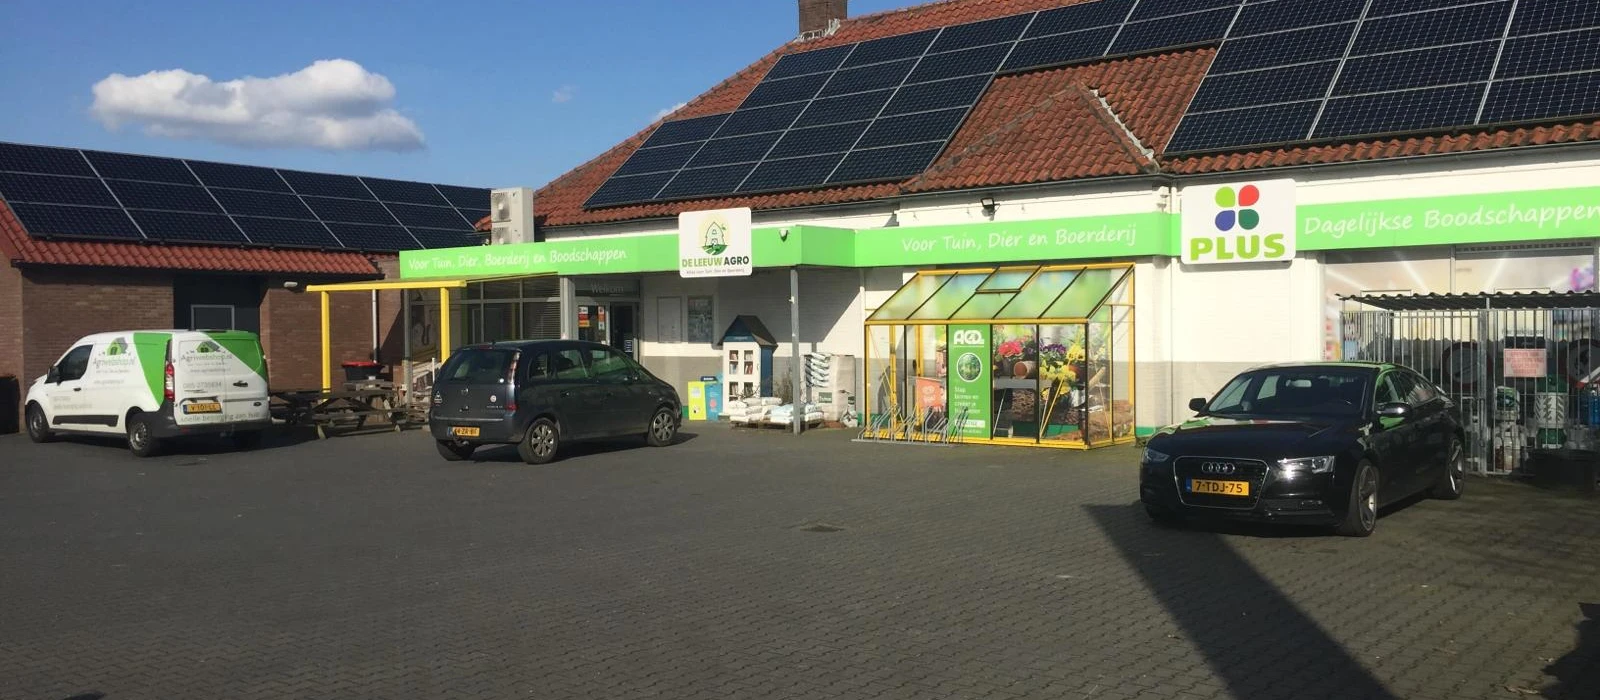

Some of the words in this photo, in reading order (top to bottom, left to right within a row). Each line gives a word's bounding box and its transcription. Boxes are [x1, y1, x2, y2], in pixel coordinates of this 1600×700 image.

[1304, 211, 1413, 239] Dagelijkse
[1423, 203, 1600, 228] Boodschappen
[902, 236, 937, 252] Voor
[943, 234, 982, 251] Tuin,
[988, 232, 1023, 248] Dier
[1028, 234, 1048, 246] en
[1055, 223, 1137, 246] Boerderij
[1190, 233, 1285, 261] PLUS
[409, 258, 430, 271] Voor
[484, 252, 530, 268] Boerderij
[533, 254, 546, 264] en
[551, 248, 627, 266] Boodschappen
[682, 258, 693, 268] DE
[694, 257, 723, 267] LEEUW
[724, 256, 750, 266] AGRO
[591, 284, 624, 295] Welkom
[1195, 480, 1243, 493] 7-TDJ-75
